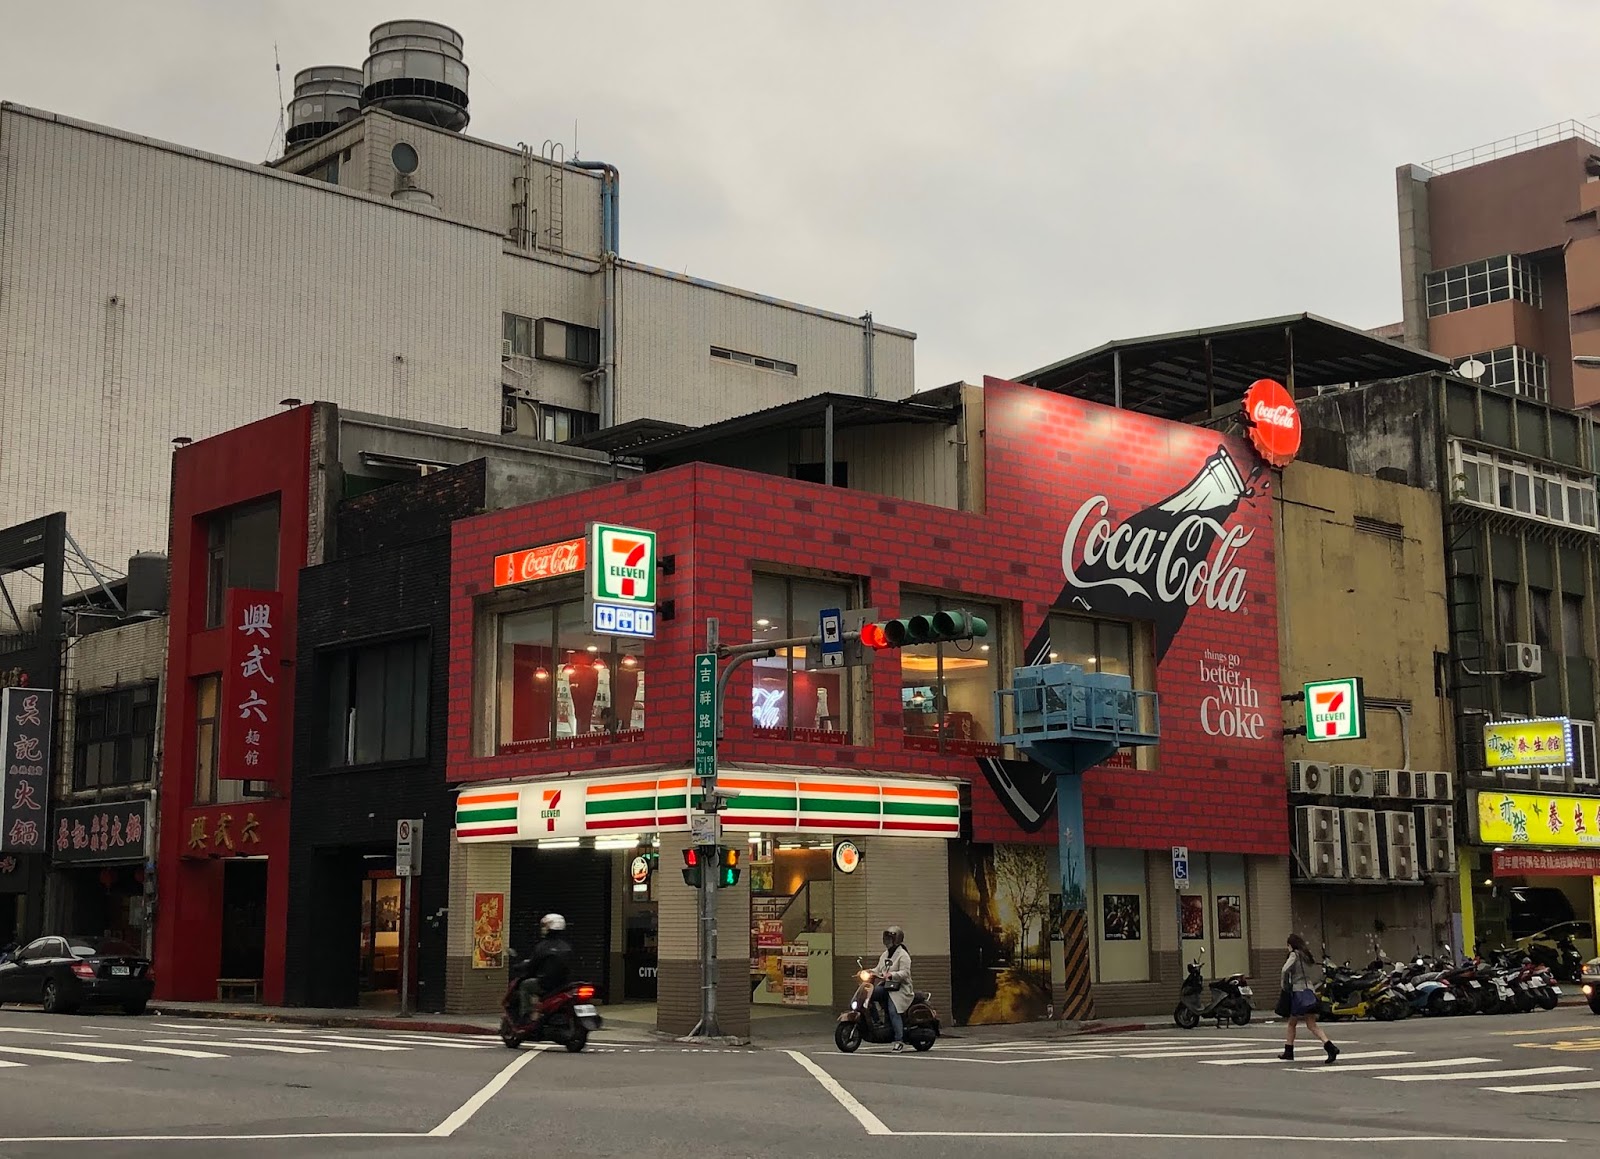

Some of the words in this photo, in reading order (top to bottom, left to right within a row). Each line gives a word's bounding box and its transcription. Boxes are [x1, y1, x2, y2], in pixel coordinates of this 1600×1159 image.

[1062, 495, 1256, 613] Coca-Cola
[1200, 659, 1241, 686] better
[1204, 648, 1228, 663] things
[1228, 653, 1240, 669] go
[699, 668, 712, 729] 吉祥路
[1218, 677, 1260, 709] with
[1200, 696, 1265, 740] Coke
[638, 966, 658, 978] CITY
